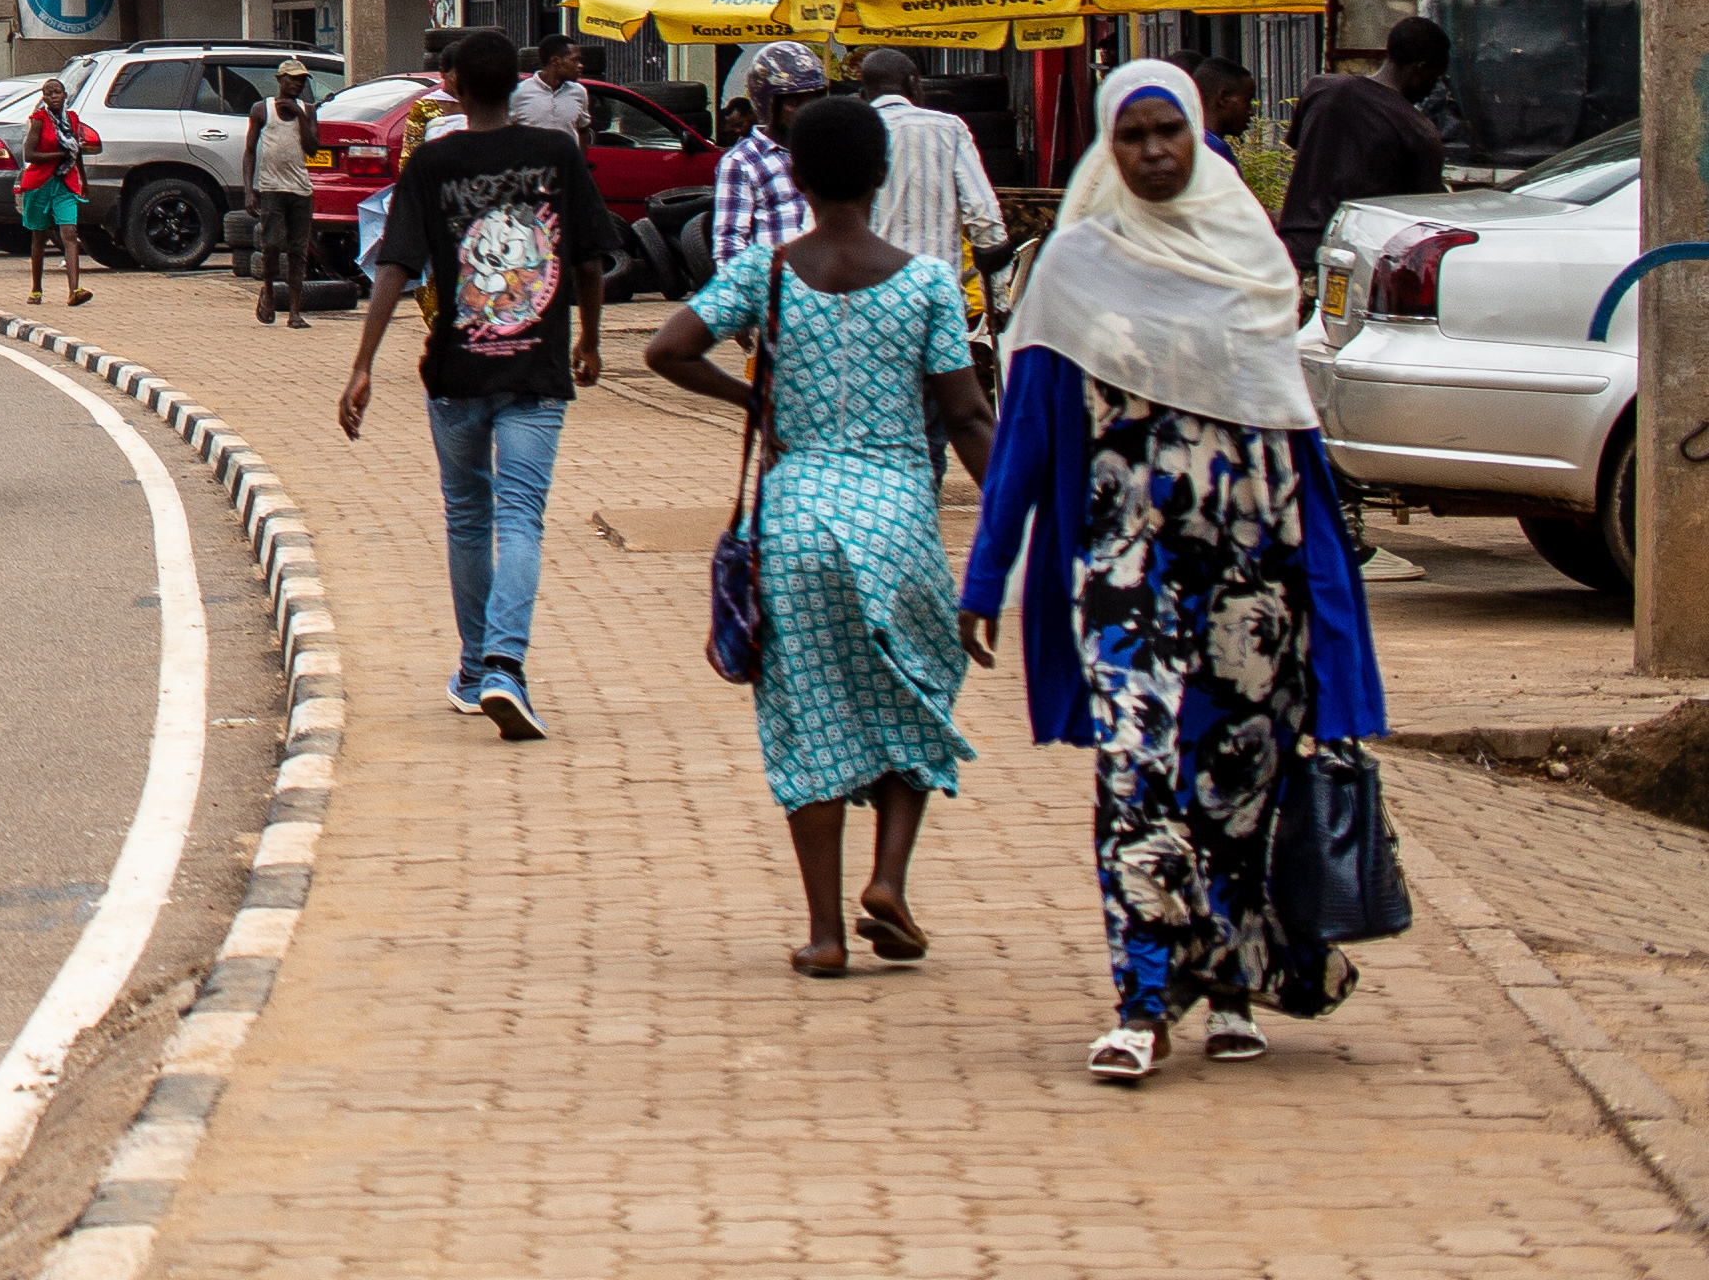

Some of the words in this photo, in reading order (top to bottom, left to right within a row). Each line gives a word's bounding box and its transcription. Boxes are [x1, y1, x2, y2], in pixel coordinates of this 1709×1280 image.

[691, 24, 742, 37] Kanda
[858, 26, 932, 40] everywhere
[933, 28, 957, 42] you
[960, 29, 978, 42] go
